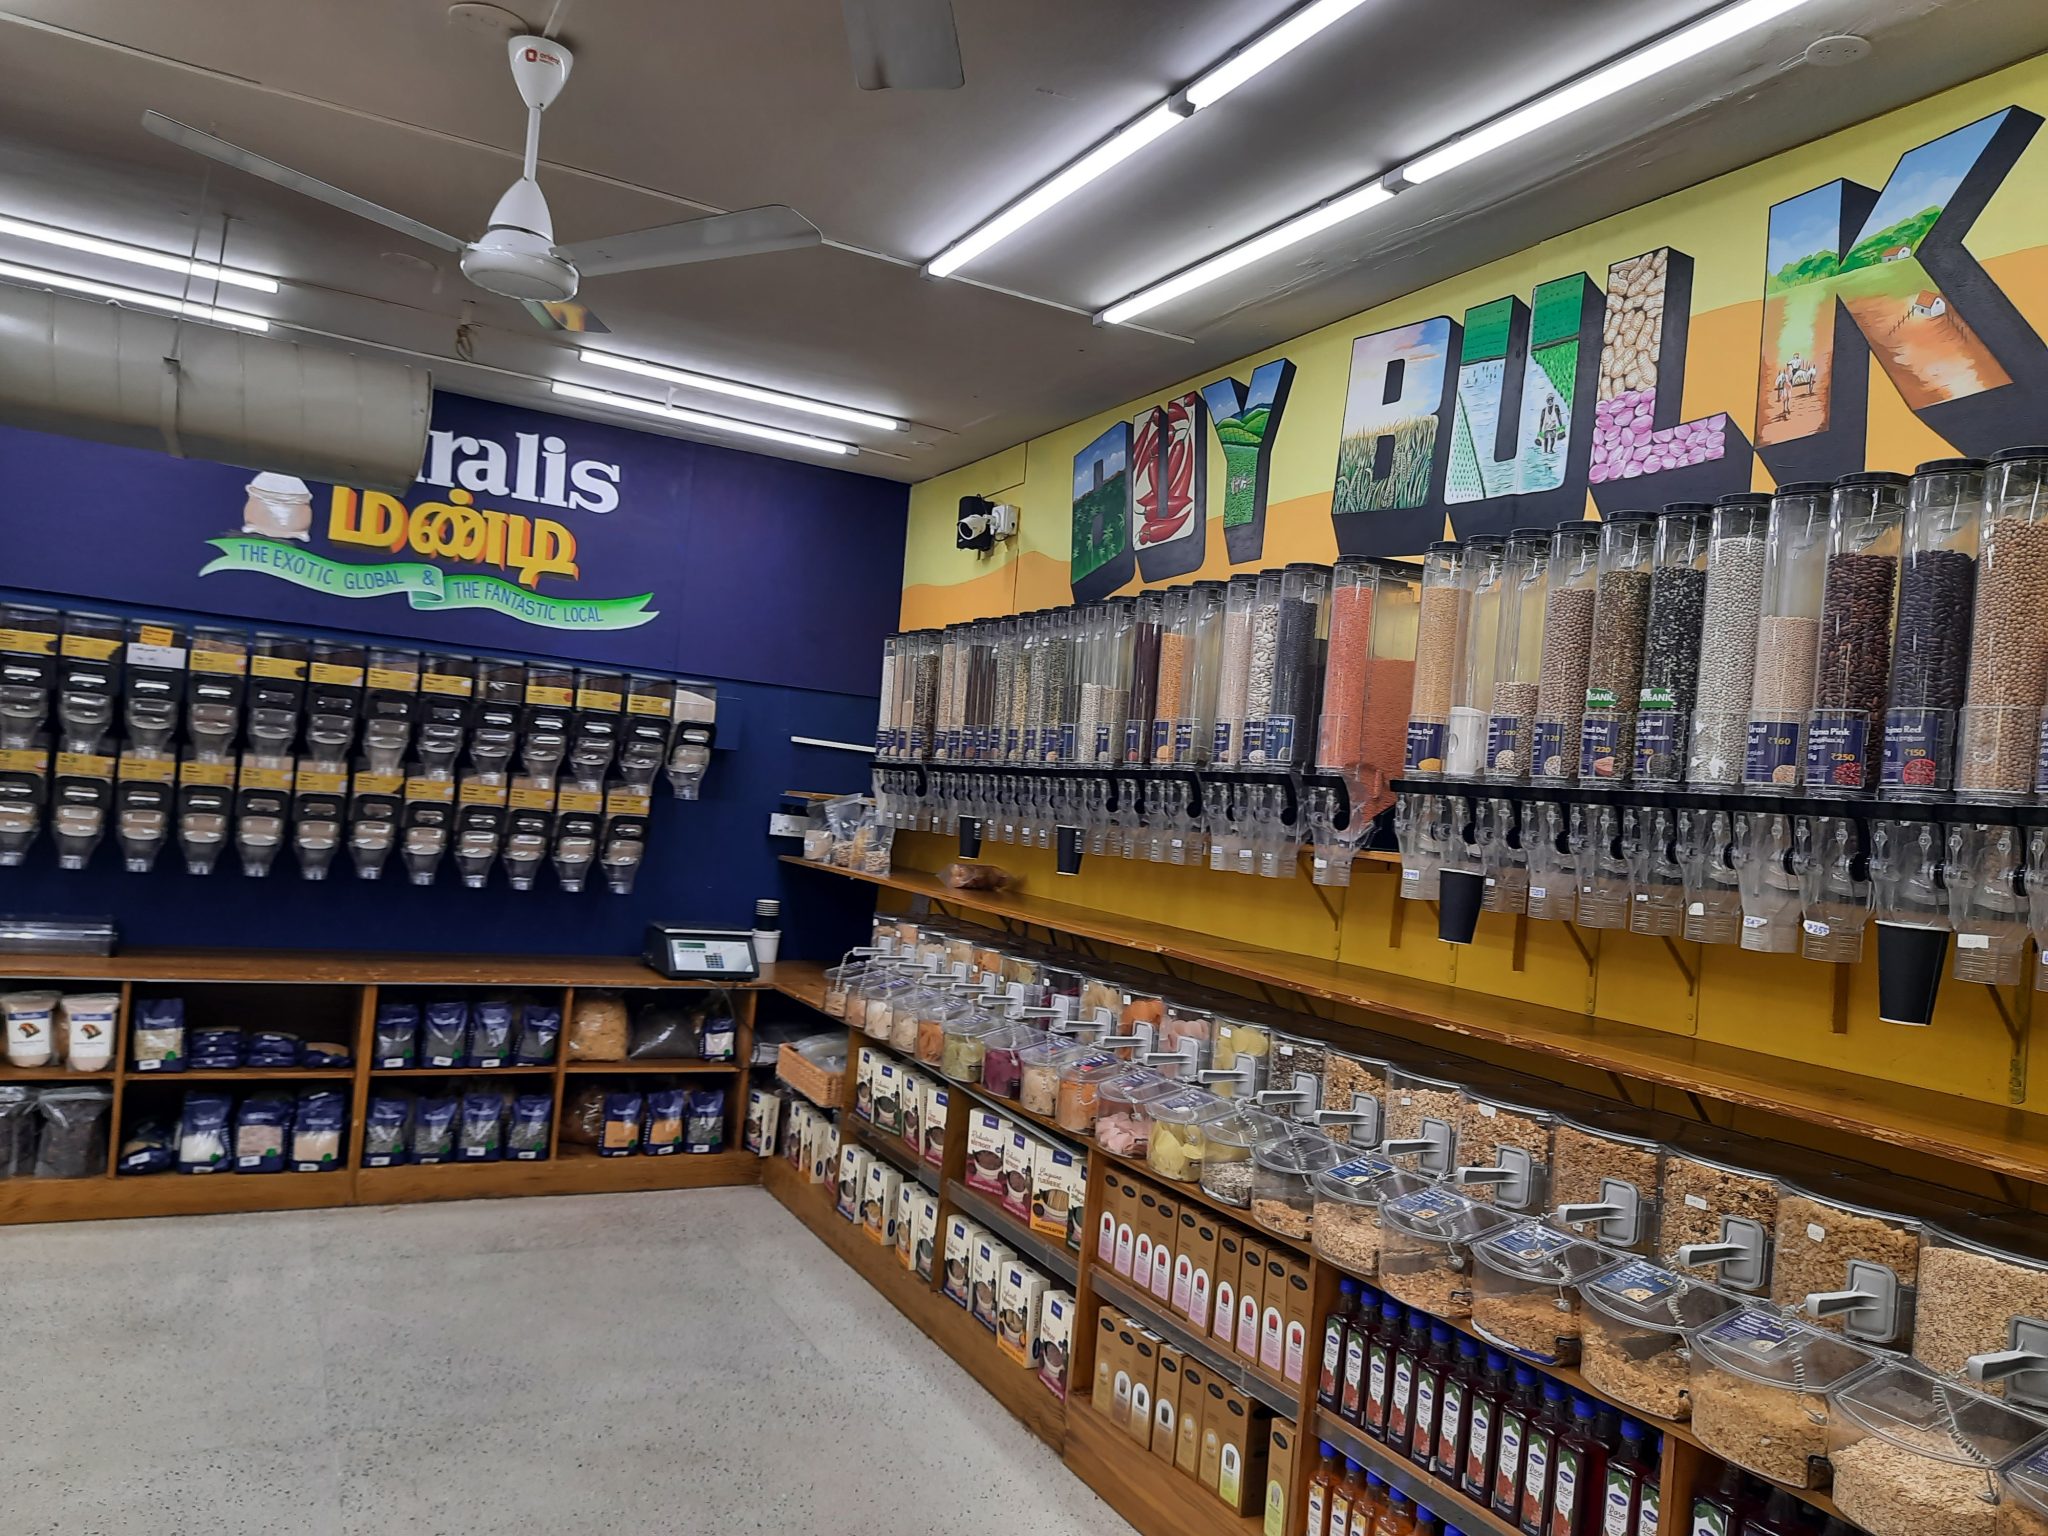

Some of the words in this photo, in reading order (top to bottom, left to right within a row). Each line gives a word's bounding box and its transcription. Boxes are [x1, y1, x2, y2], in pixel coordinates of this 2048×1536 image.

[1071, 358, 1296, 596] BUY
[1332, 105, 2040, 545] BULK
[417, 430, 621, 514] ralis
[239, 543, 268, 564] THE
[272, 549, 333, 585] EXOTIC
[344, 569, 405, 590] GLOBAL
[422, 569, 436, 587] &
[454, 580, 480, 602] THE
[484, 582, 557, 621] FANTASTIC
[563, 604, 604, 624] LOCAL
[1748, 725, 1767, 733] Urad
[1830, 727, 1850, 736] Pink
[1904, 725, 1922, 733] Red
[1748, 735, 1759, 744] Dal
